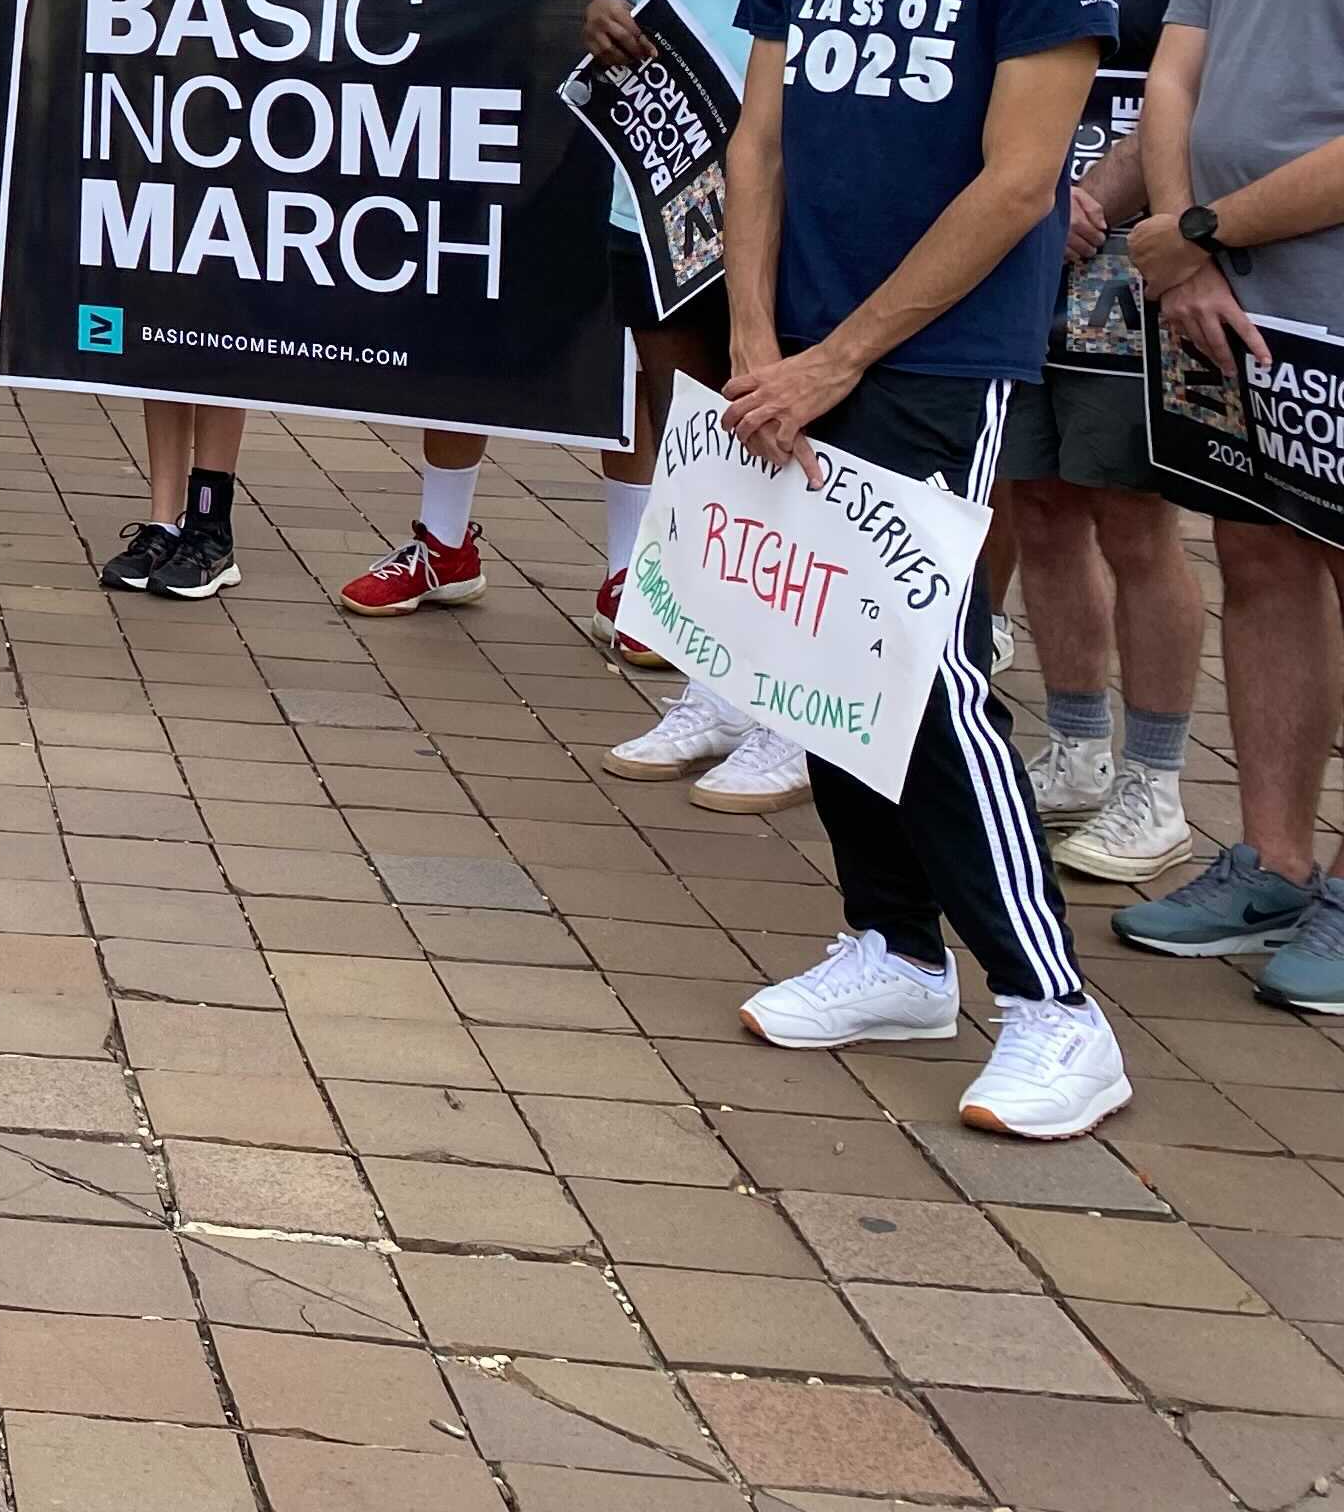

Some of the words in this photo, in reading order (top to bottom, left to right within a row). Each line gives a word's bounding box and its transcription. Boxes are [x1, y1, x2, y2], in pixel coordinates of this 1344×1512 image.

[82, 72, 522, 185] INCOME
[611, 100, 672, 196] BASIC
[79, 178, 504, 300] MARCH
[141, 325, 409, 368] BASICINCOMEMARCH.COM
[1208, 440, 1254, 477] 2021
[668, 507, 679, 542] A
[702, 502, 849, 638] RIGHT
[806, 450, 950, 610] DESERVES
[635, 541, 732, 678] GUARANTEED
[750, 672, 882, 746] INCOME!
[860, 598, 881, 620] TO
[870, 639, 883, 658] A
